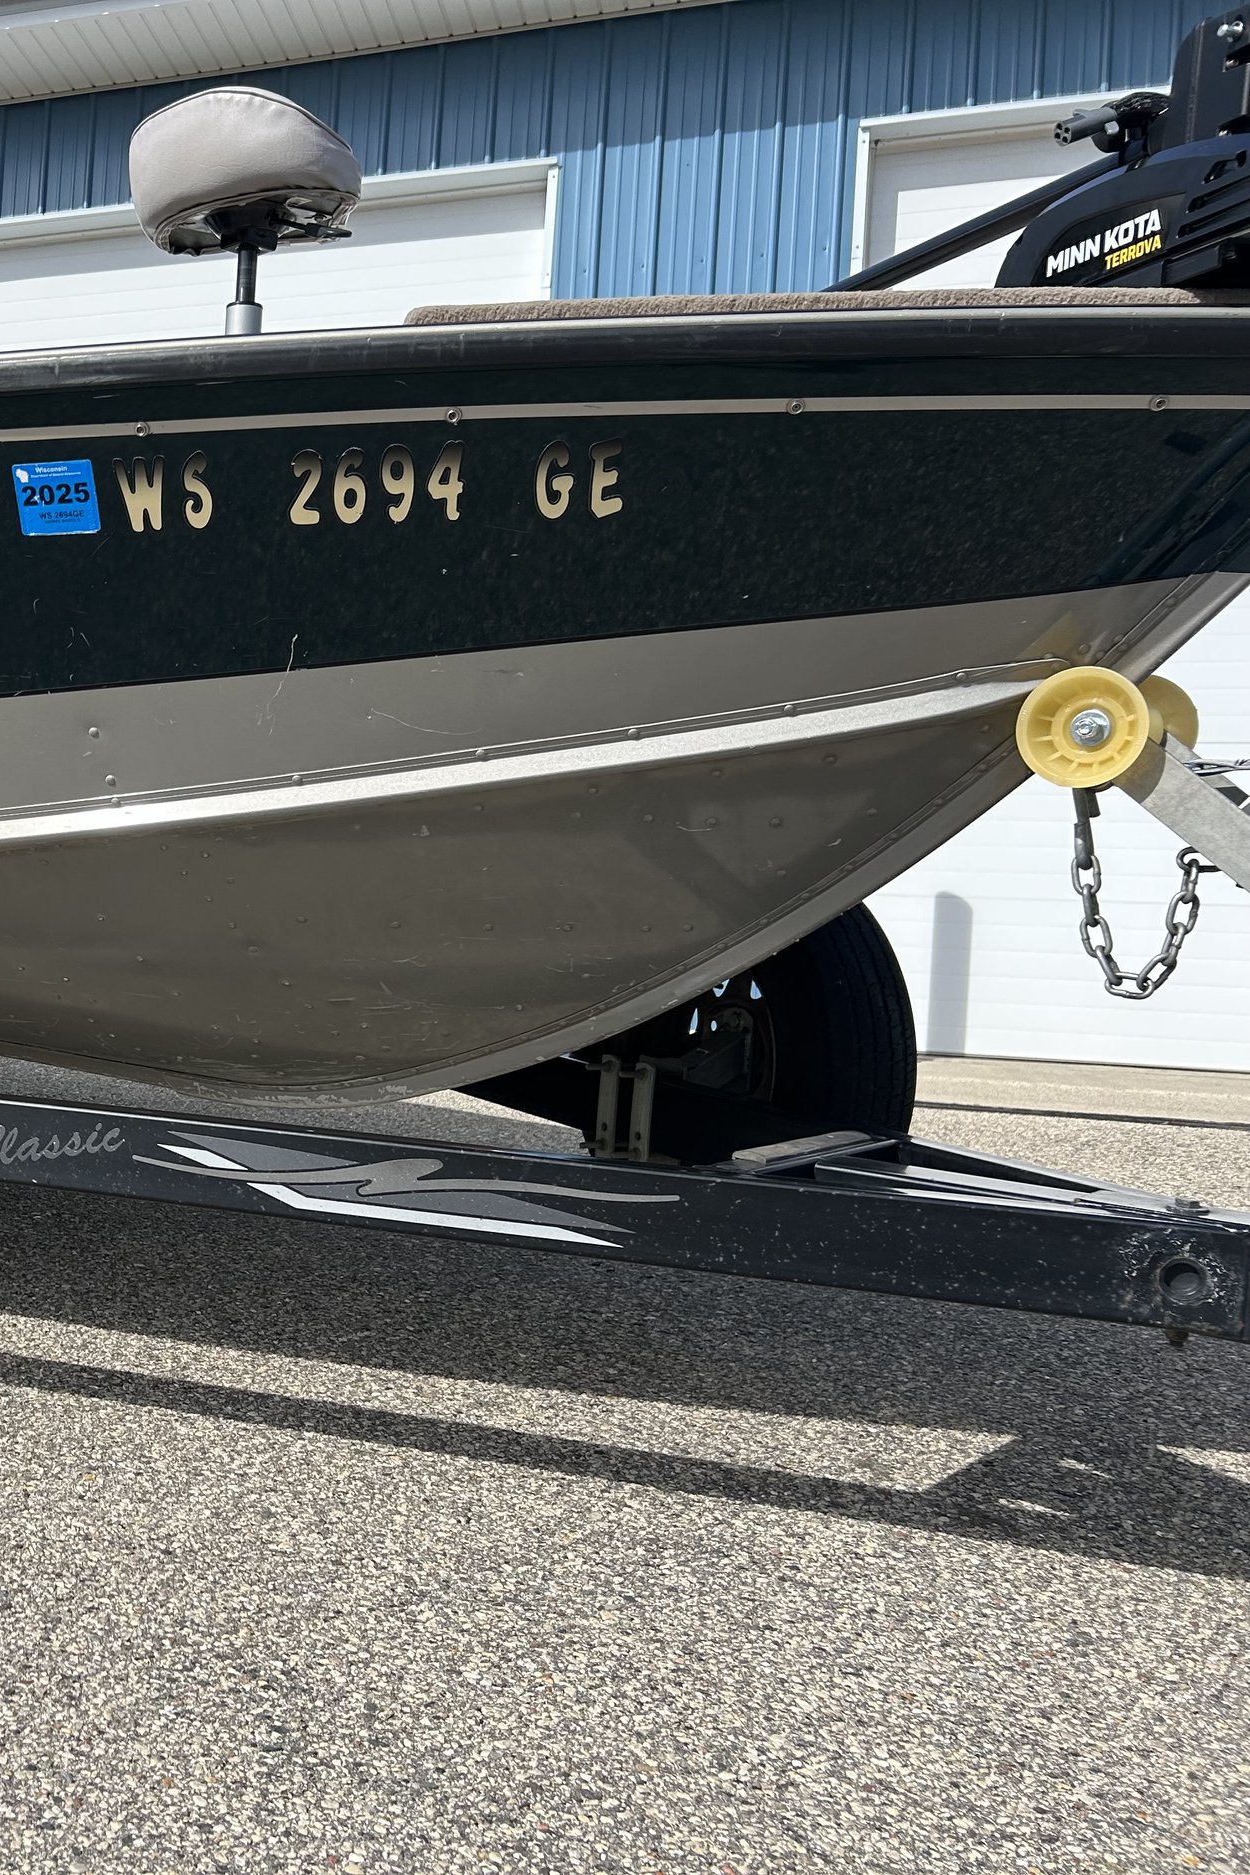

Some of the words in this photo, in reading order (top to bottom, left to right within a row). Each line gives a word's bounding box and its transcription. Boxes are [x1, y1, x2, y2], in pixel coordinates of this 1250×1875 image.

[1046, 234, 1101, 278] MINN
[1104, 208, 1161, 253] KOTA
[1104, 234, 1162, 270] TERROVA
[35, 465, 67, 474] Wisconsin
[21, 482, 90, 506] 2025
[112, 450, 214, 533] WS
[289, 439, 465, 525] 2694
[535, 439, 623, 520] GE
[38, 511, 53, 520] WS
